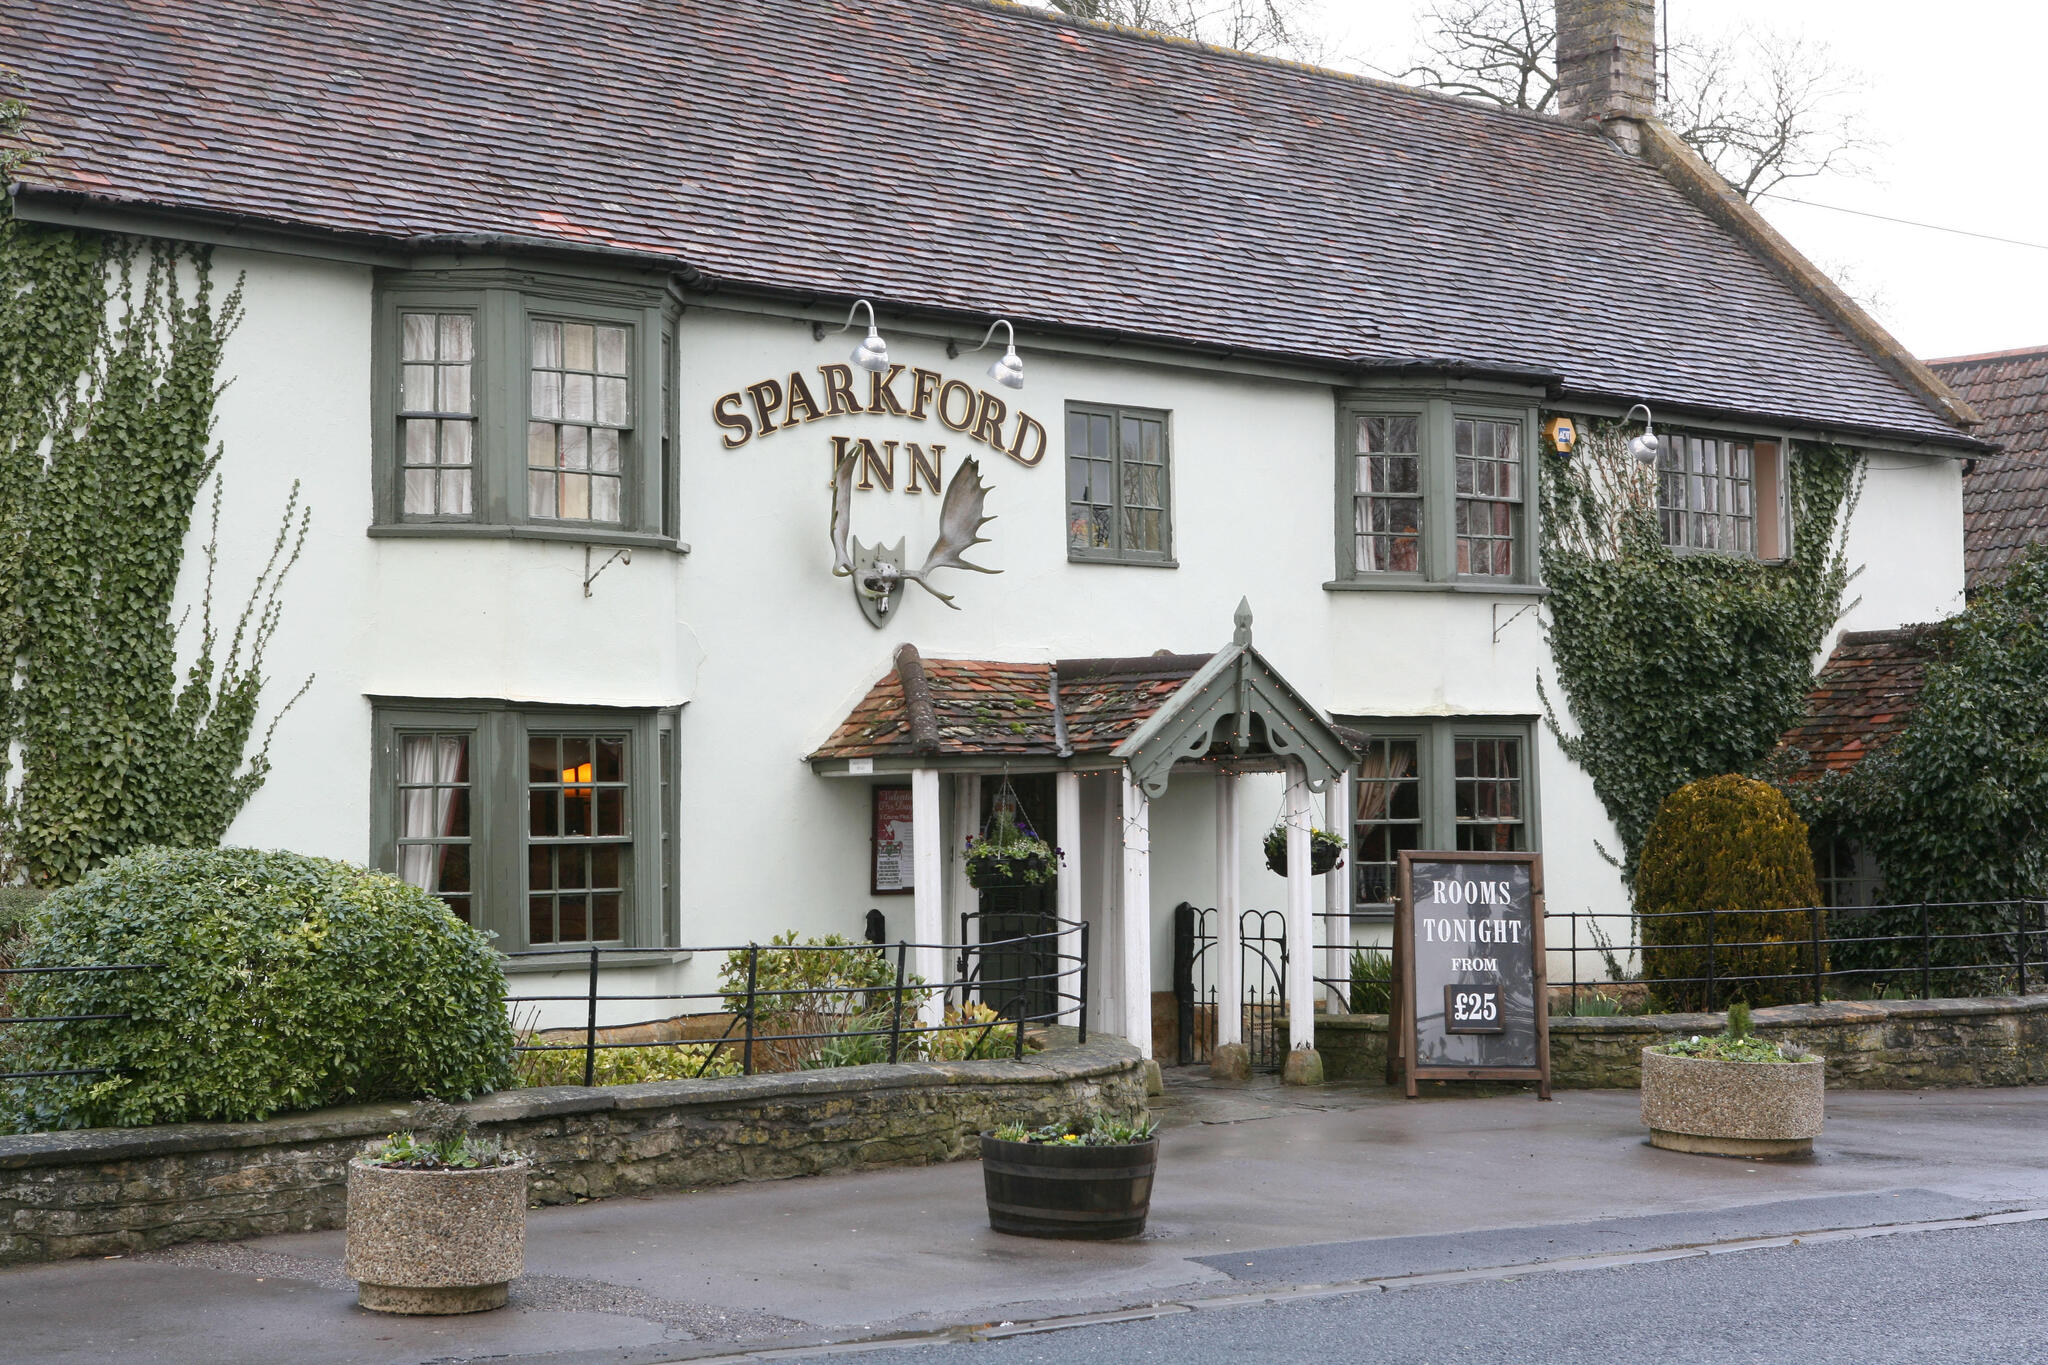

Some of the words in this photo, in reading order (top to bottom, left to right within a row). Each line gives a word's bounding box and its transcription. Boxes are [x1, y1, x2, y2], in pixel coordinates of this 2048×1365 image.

[712, 363, 1047, 468] SPARKFORD
[829, 435, 946, 494] INN
[1432, 880, 1511, 905] ROOMS
[1423, 918, 1522, 944] TONIGHT
[1451, 958, 1498, 972] FROM
[1454, 992, 1497, 1021] £25
